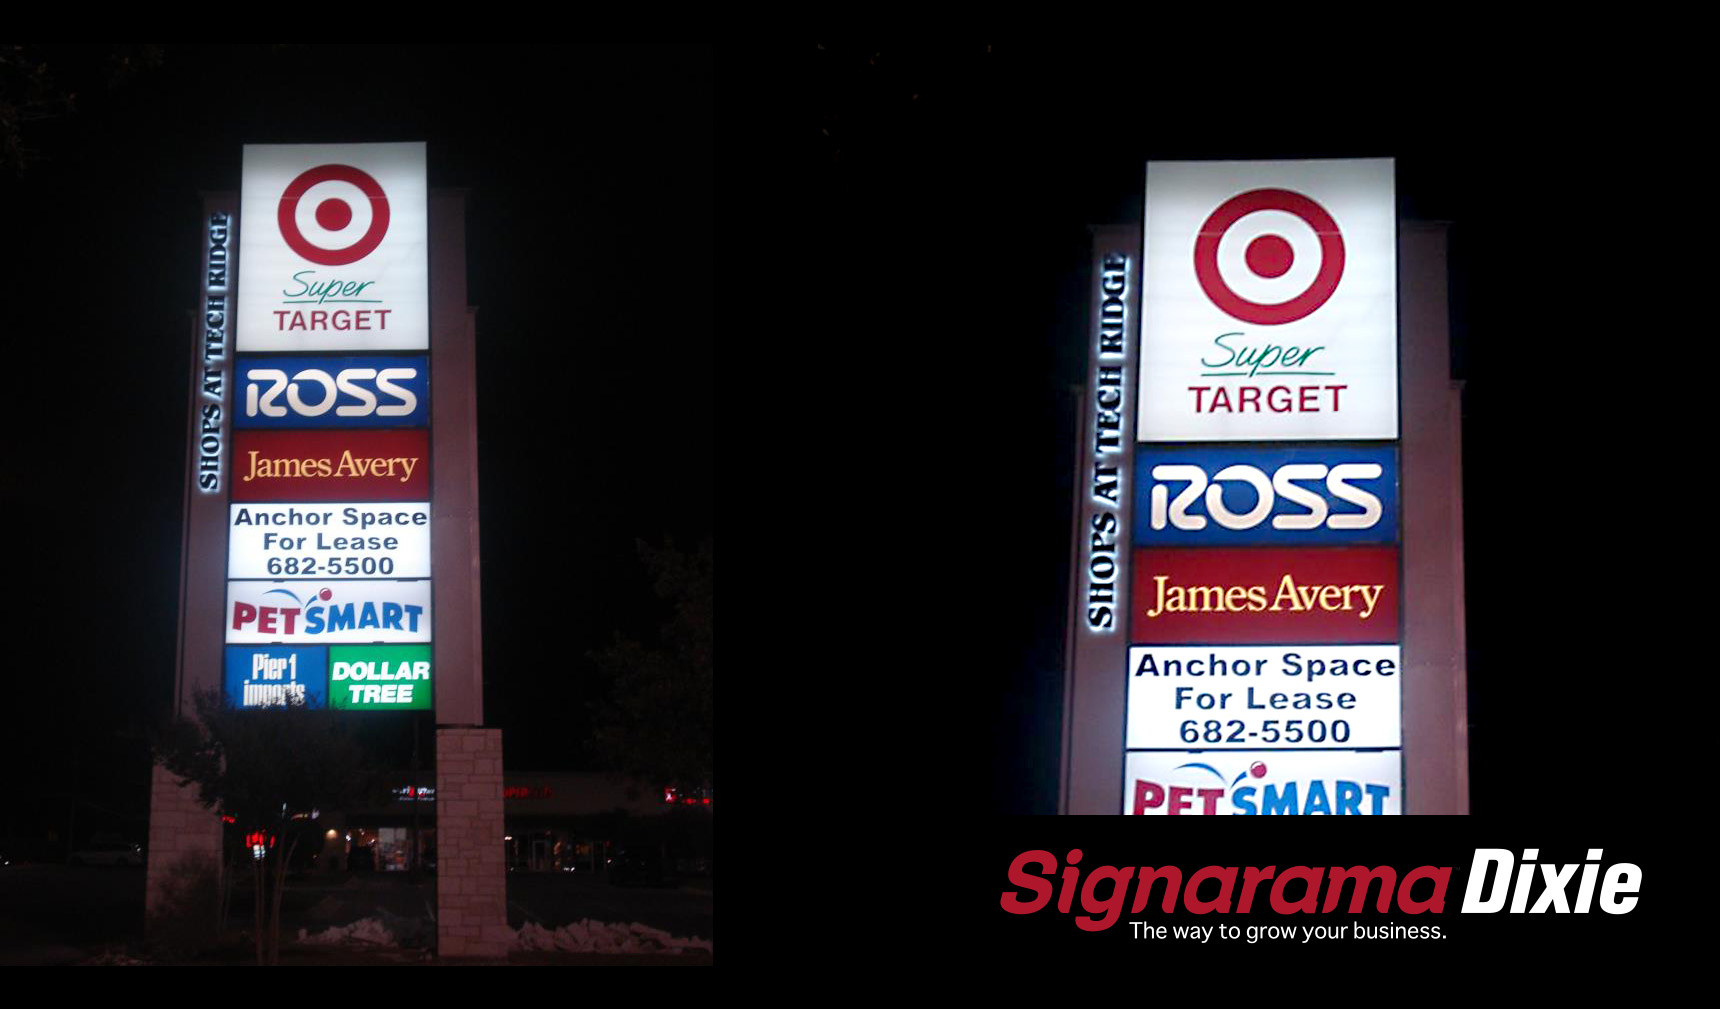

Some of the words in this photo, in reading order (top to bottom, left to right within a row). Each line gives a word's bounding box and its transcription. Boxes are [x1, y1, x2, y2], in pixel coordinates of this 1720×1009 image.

[208, 212, 230, 288] RIDGE
[283, 270, 375, 304] Super
[273, 309, 392, 331] TARGET
[1099, 253, 1128, 358] RIDGE
[205, 295, 226, 361] TECH
[1201, 332, 1325, 378] Super
[204, 366, 223, 398] AT
[246, 368, 418, 417] ROSS
[1096, 366, 1123, 455] TECH
[1188, 385, 1348, 413] TARGET
[200, 403, 221, 492] SHOPS
[243, 451, 332, 481] James
[334, 450, 419, 482] Avery
[1092, 464, 1119, 502] AT
[1151, 463, 1382, 530] ROSS
[234, 508, 333, 526] Anchor
[342, 508, 427, 530] Space
[263, 533, 306, 550] For
[317, 533, 398, 550] Lease
[267, 557, 394, 575] 682-5500
[1088, 512, 1118, 631] SHOPS
[1147, 576, 1266, 617] James
[1269, 574, 1384, 618] Avery
[252, 653, 287, 680] Pier
[289, 653, 297, 680] 1
[332, 661, 430, 681] DOLLAR
[1135, 653, 1267, 677] Anchor
[1281, 652, 1396, 682] Space
[349, 684, 413, 703] TREE
[1175, 686, 1232, 710] For
[1247, 686, 1357, 710] Lease
[1180, 719, 1350, 743] 682-5500
